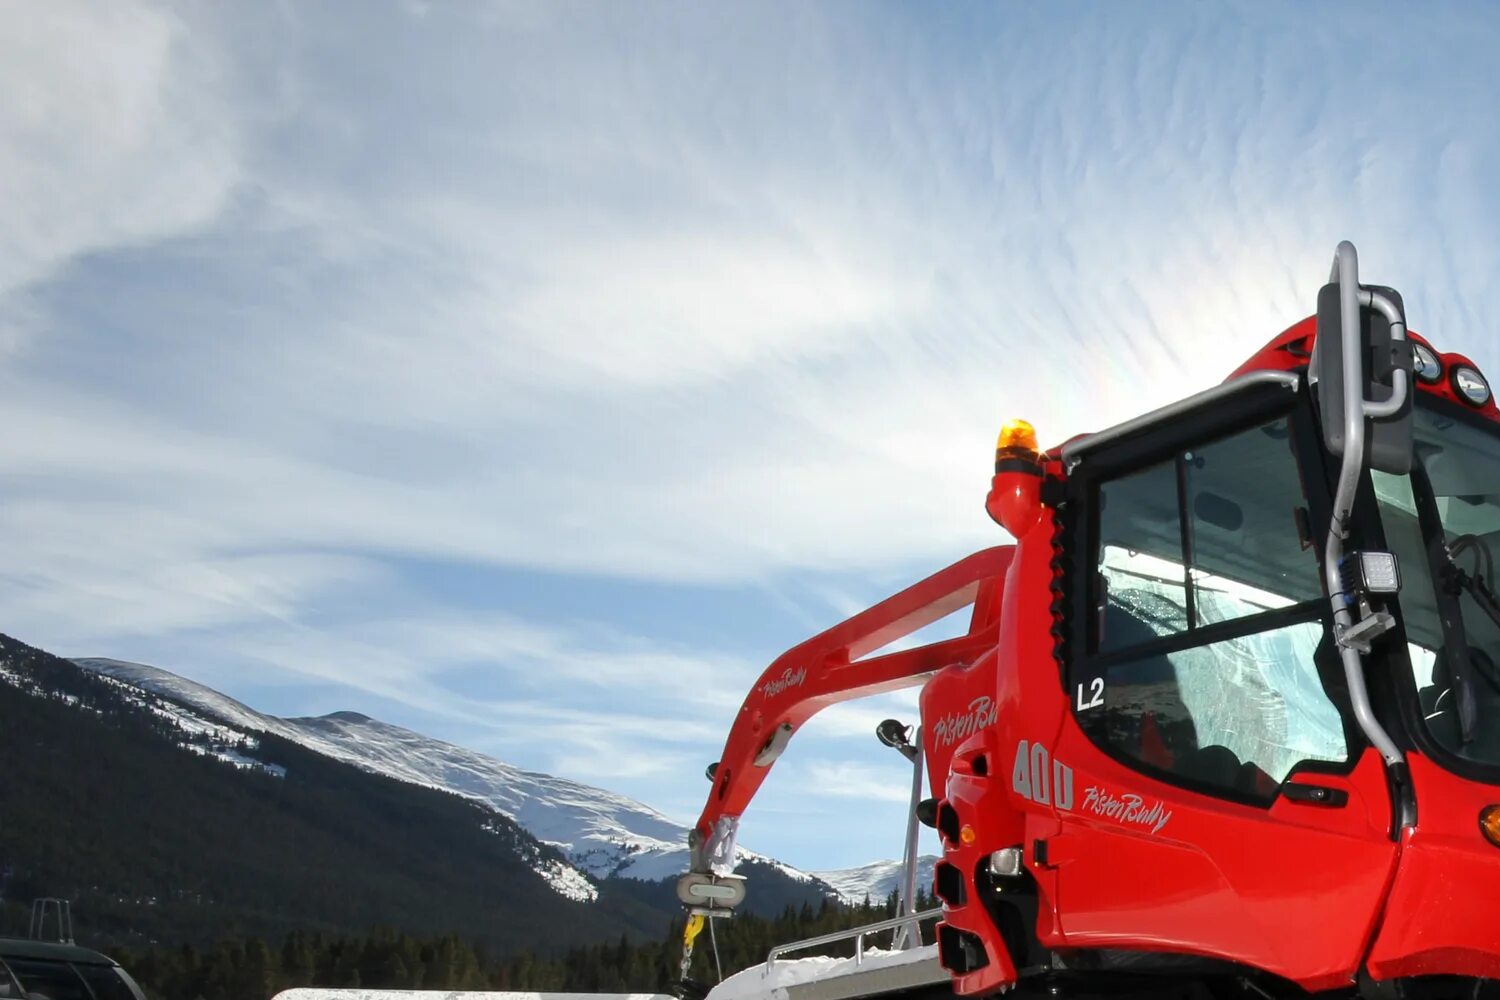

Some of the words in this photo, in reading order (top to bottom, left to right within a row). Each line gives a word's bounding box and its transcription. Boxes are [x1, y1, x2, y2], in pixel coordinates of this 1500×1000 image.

[1076, 677, 1105, 712] L2
[933, 695, 998, 753] PistenBu
[1011, 739, 1074, 811] 400
[1081, 785, 1173, 836] PistenBully
